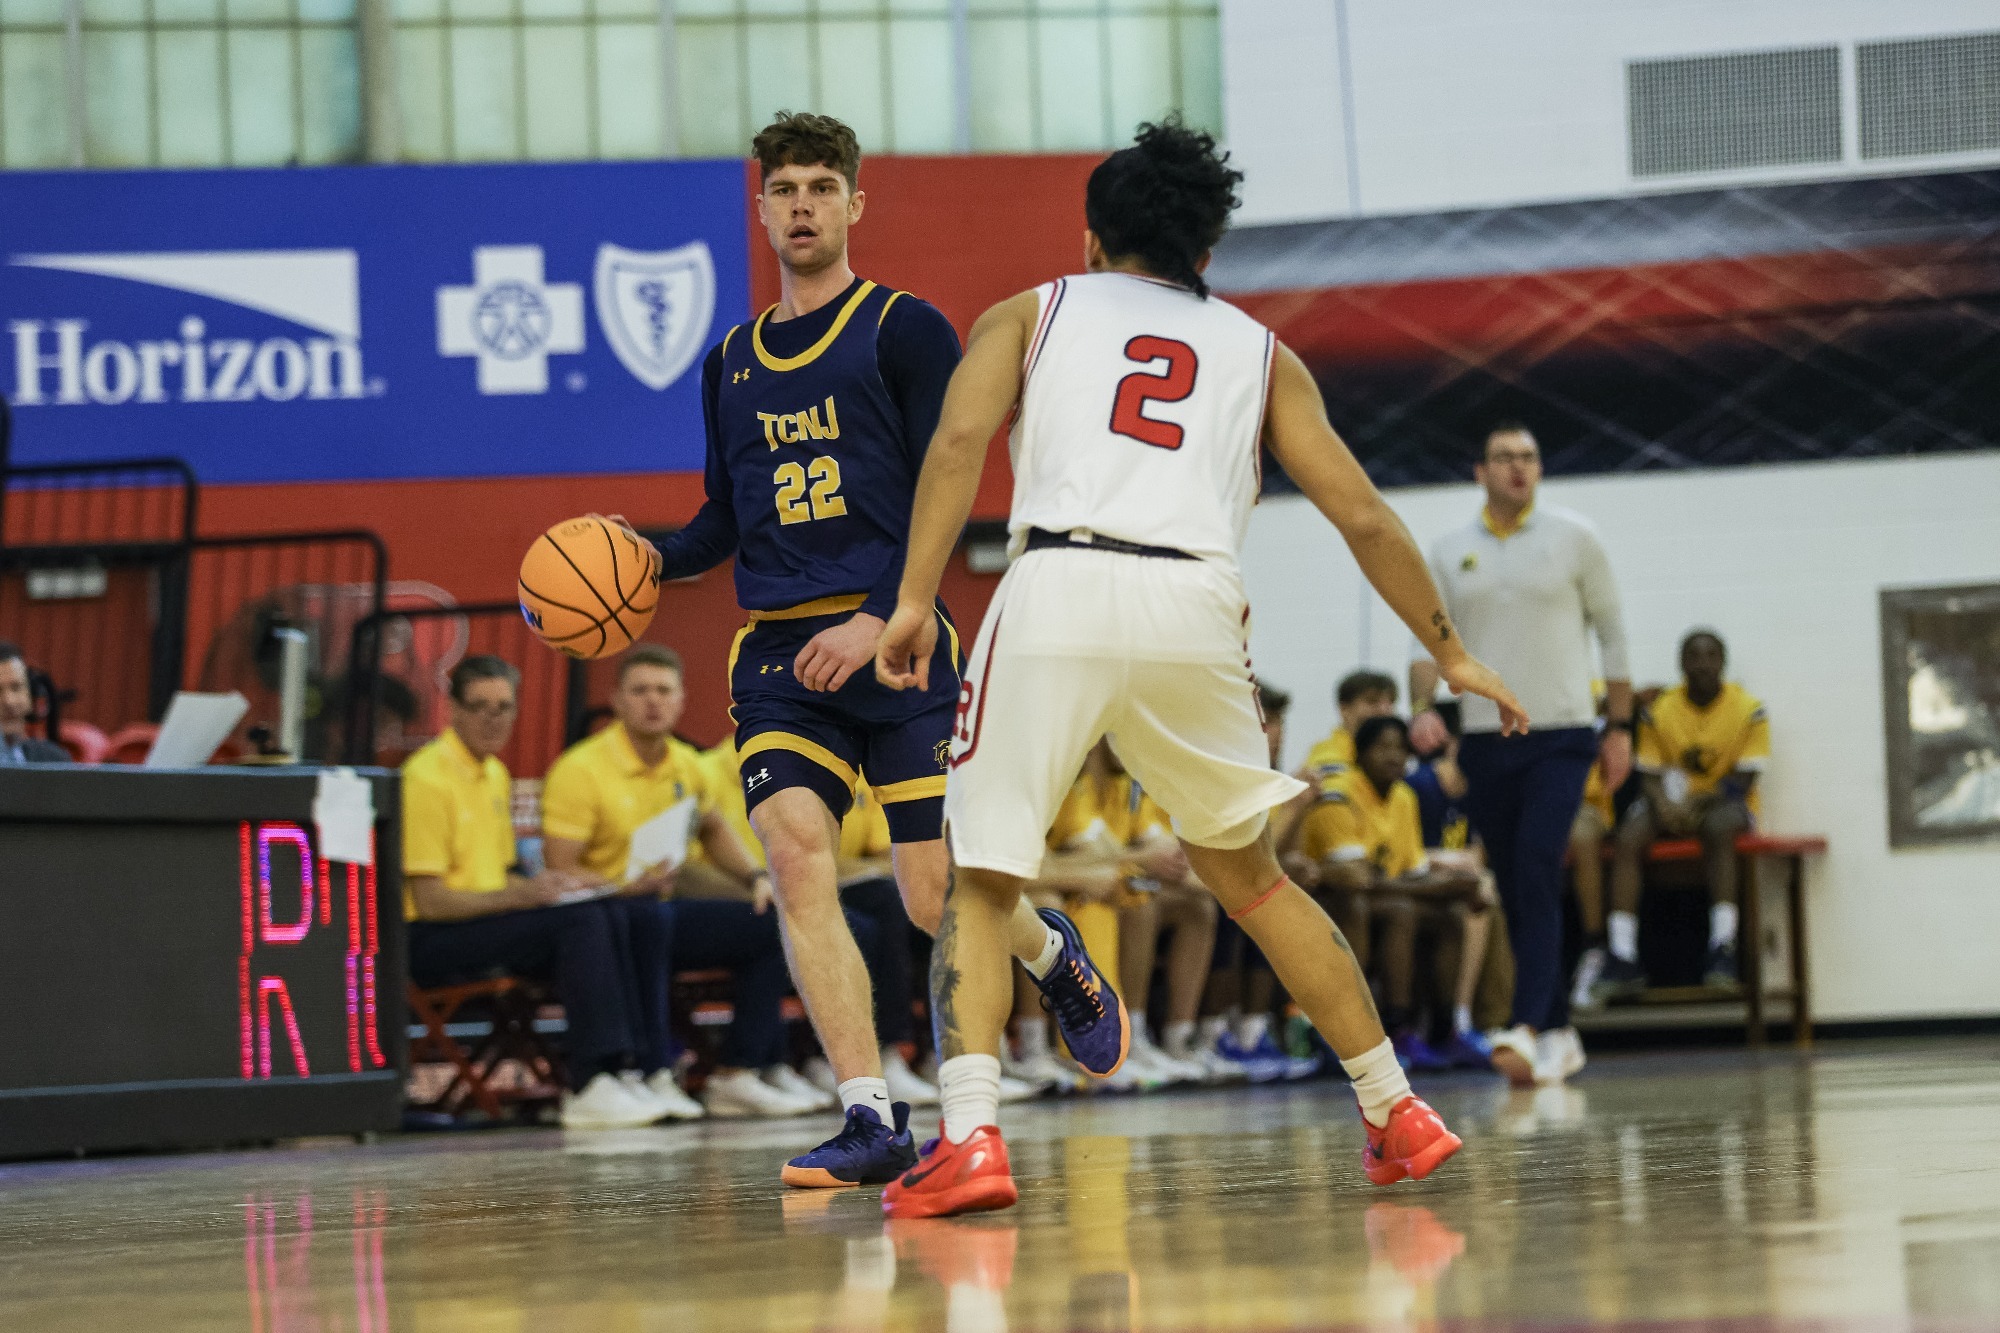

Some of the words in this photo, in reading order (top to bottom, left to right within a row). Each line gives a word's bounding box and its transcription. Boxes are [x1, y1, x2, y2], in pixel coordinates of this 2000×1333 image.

[7, 315, 364, 405] Horizon
[1109, 334, 1199, 451] 2
[756, 395, 841, 453] TCNJ
[773, 455, 848, 526] 22
